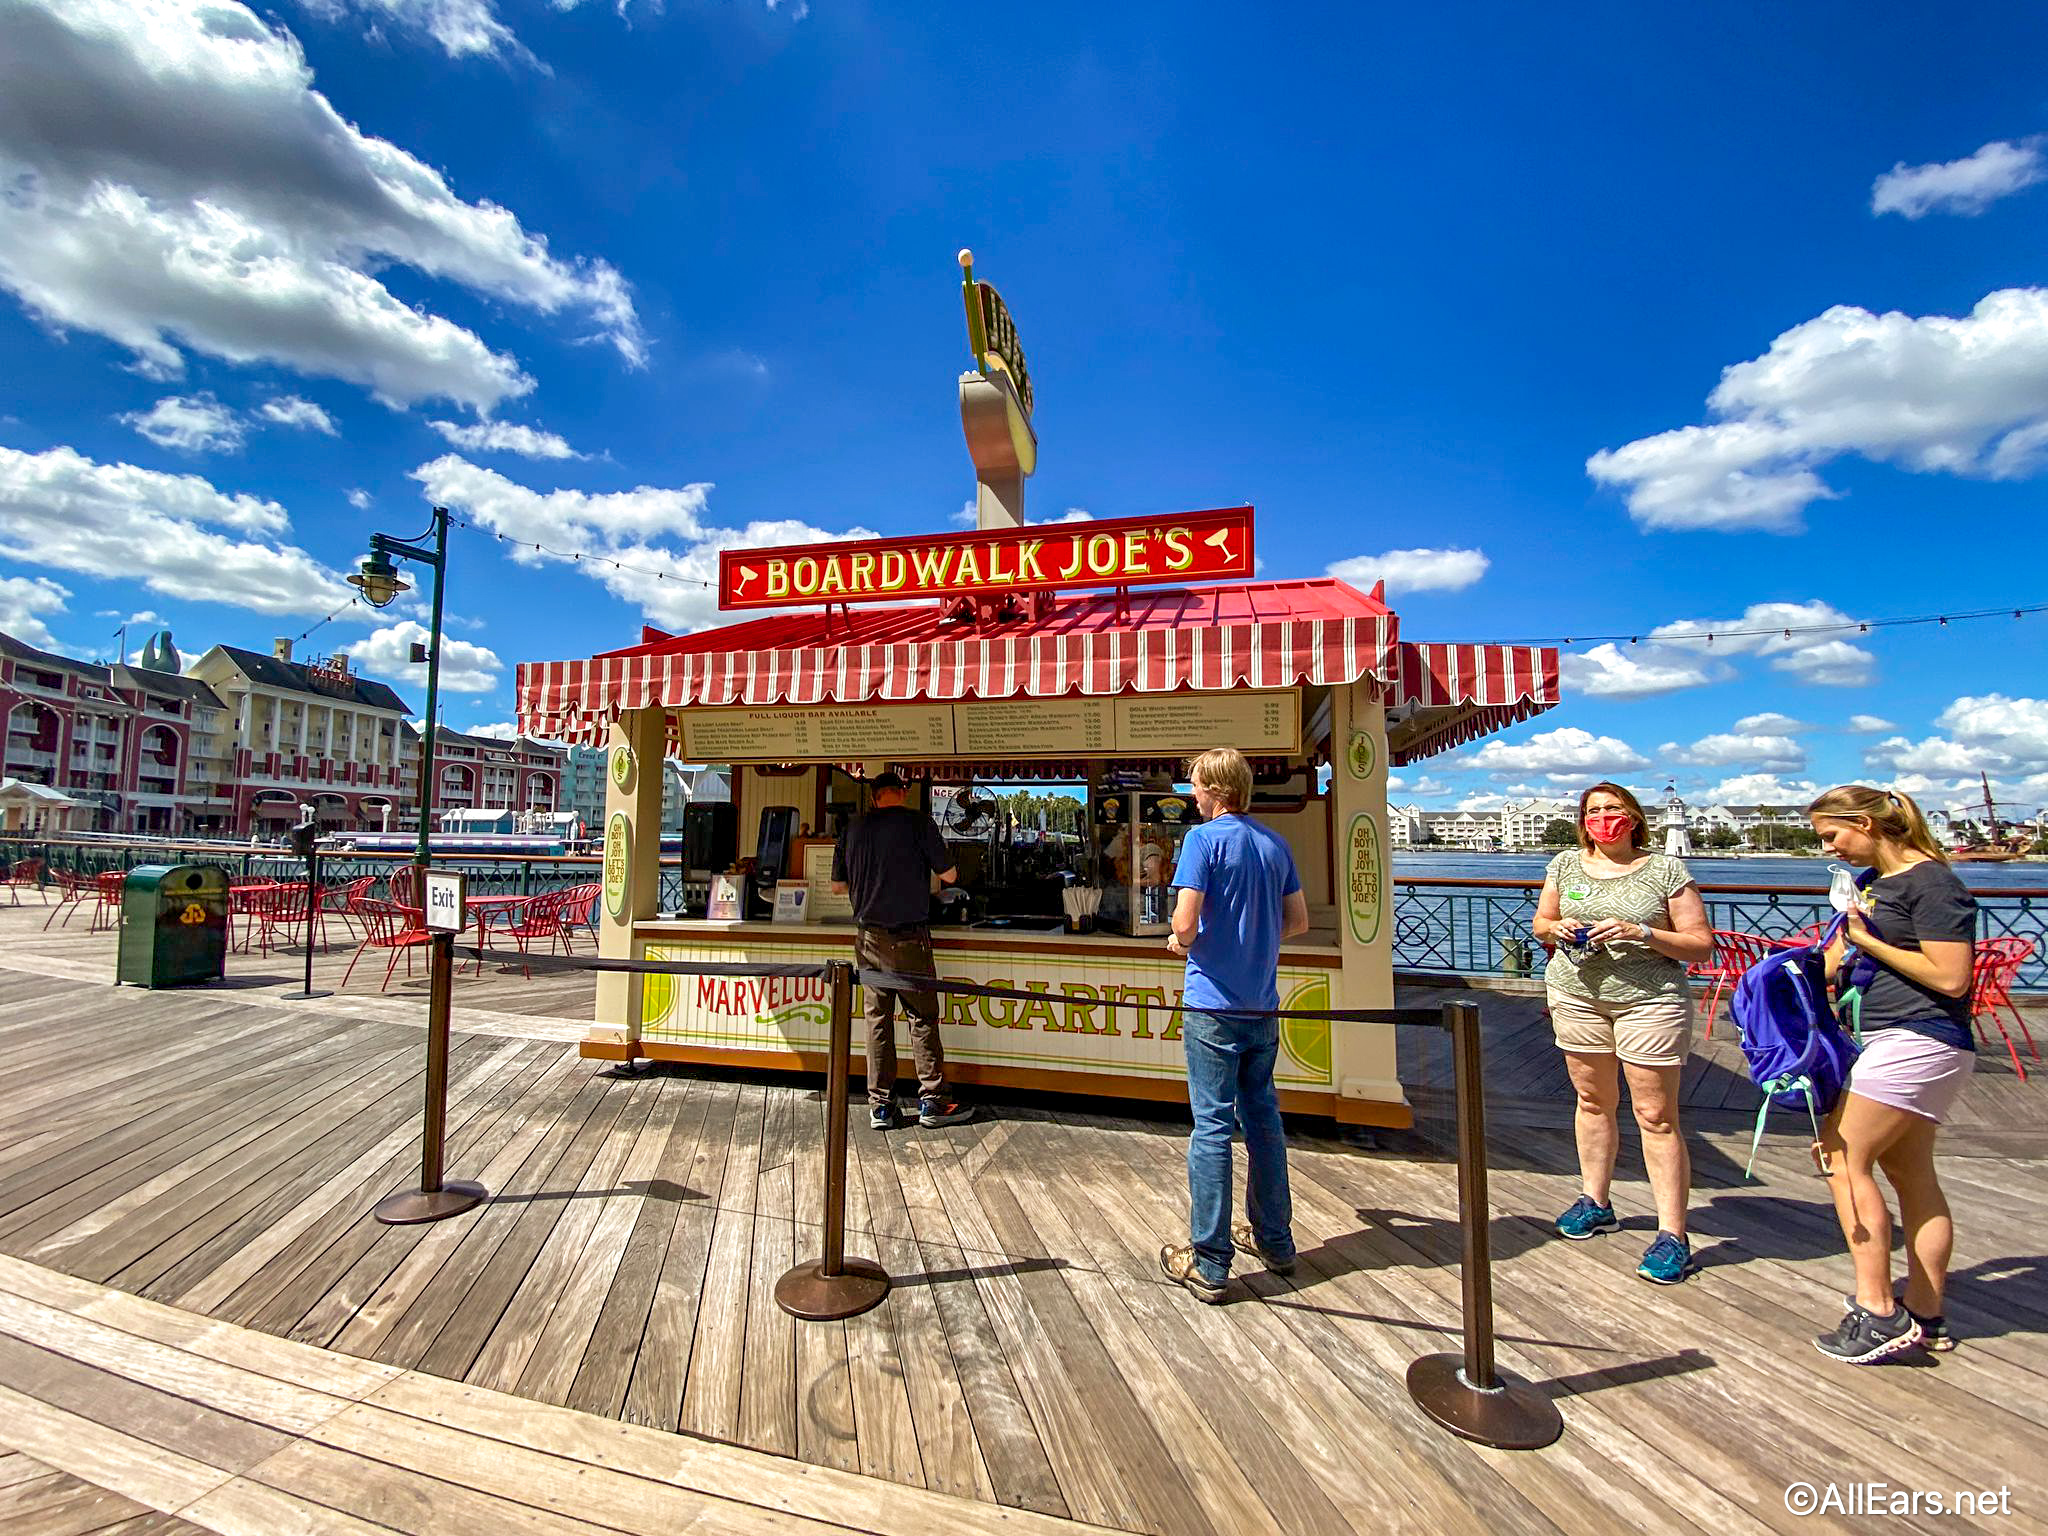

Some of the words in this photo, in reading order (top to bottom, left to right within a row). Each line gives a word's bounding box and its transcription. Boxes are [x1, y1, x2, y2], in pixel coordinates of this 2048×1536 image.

[766, 539, 1048, 597] BOARDWALK
[1059, 527, 1193, 580] JOE'S
[933, 787, 952, 798] NCE
[614, 824, 622, 832] OH
[1358, 828, 1369, 838] OH
[611, 832, 624, 840] BOY!
[613, 841, 621, 849] OH
[1354, 838, 1374, 848] BOY!
[610, 849, 624, 857] JOY!
[1358, 850, 1370, 860] OH
[609, 859, 624, 867] LET'S
[1355, 860, 1374, 870] JOY!
[608, 867, 616, 875] GO
[616, 867, 625, 875] TO
[1352, 872, 1377, 883] LET'S
[1352, 883, 1364, 893] GO
[1365, 882, 1378, 893] TO
[432, 886, 455, 909] Exit
[1354, 892, 1377, 903] JOE'S
[696, 974, 834, 1016] MARVELOU
